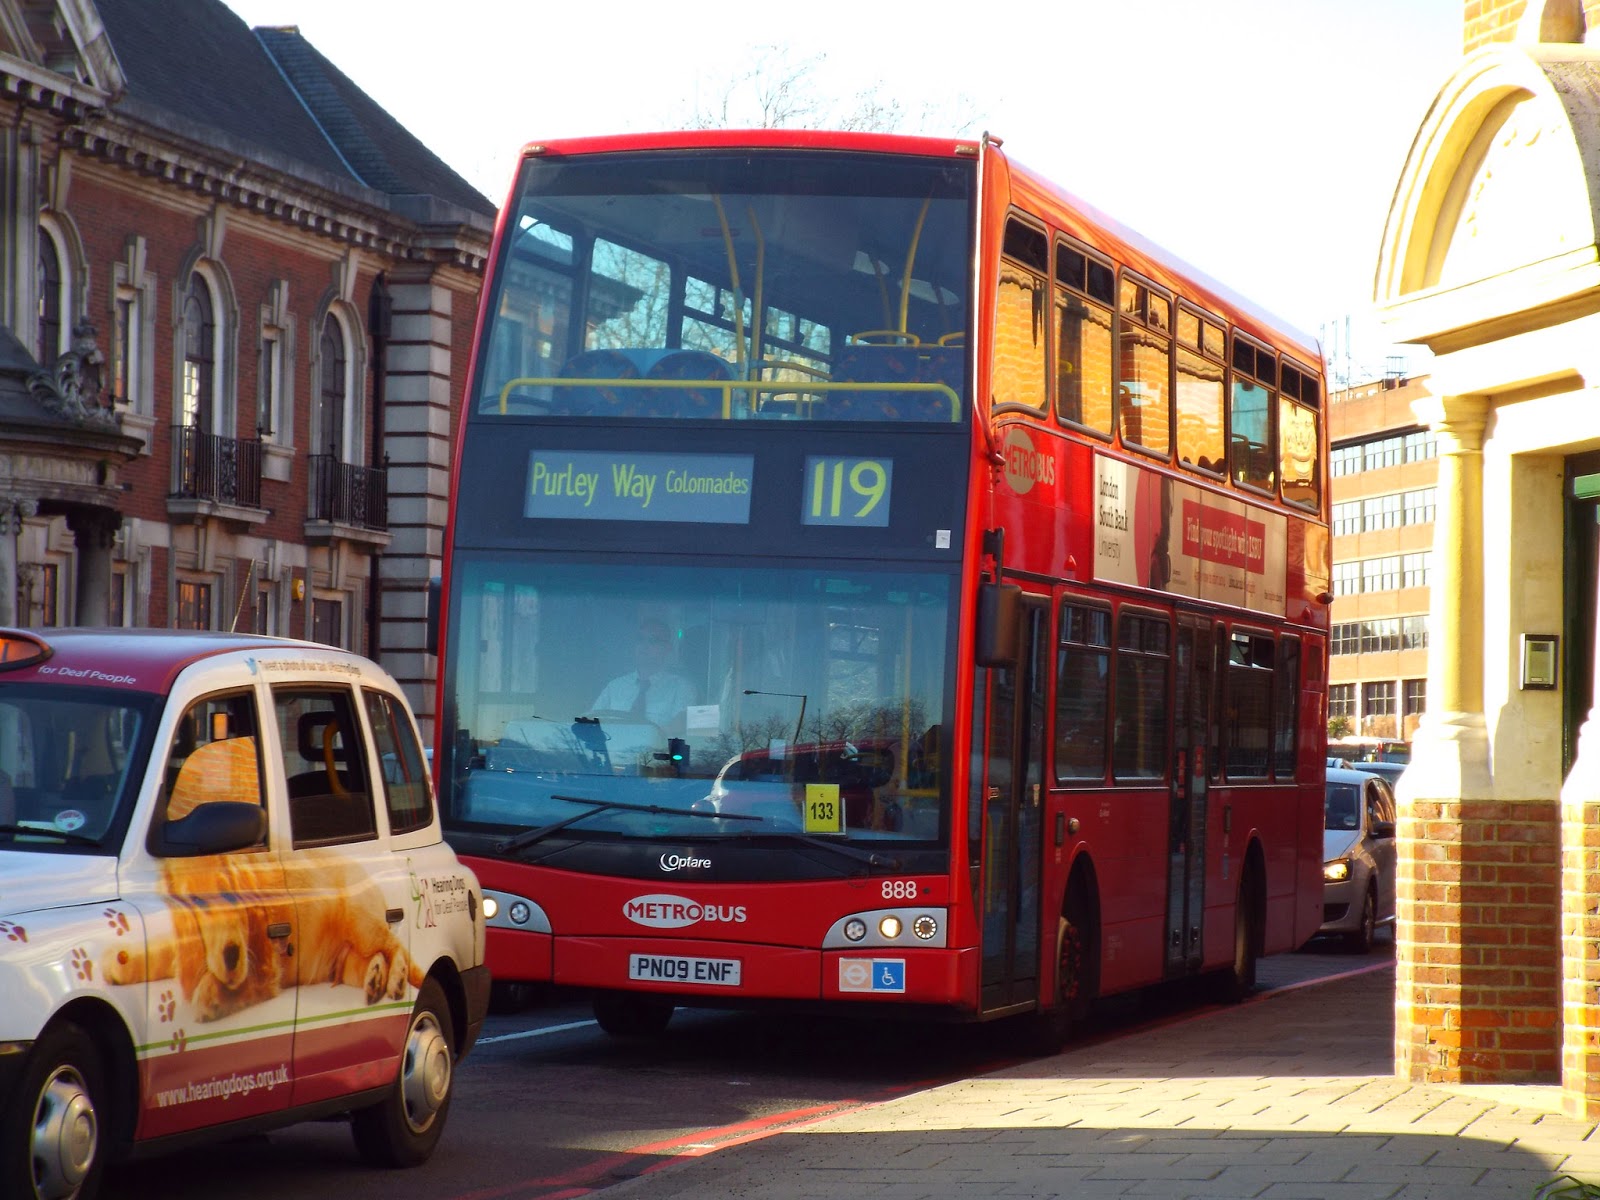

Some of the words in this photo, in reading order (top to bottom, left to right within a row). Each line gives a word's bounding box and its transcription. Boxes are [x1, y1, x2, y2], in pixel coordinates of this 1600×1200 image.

[1003, 444, 1056, 486] METROBUS
[531, 462, 598, 507] Purley
[612, 463, 656, 508] Way
[666, 470, 749, 494] Colonnades
[812, 459, 888, 518] 119
[1100, 474, 1119, 500] London
[38, 665, 57, 674] for
[58, 667, 91, 678] Deaf
[89, 670, 137, 685] People
[810, 802, 834, 820] 133
[668, 855, 711, 870] Optare
[431, 877, 455, 895] Hearing
[453, 875, 466, 894] Dogs
[881, 880, 918, 899] 888
[627, 901, 747, 923] METROBUS
[637, 957, 689, 979] PN09
[694, 961, 734, 981] ENF
[156, 1063, 289, 1107] www.hearingdogs.org.uk
